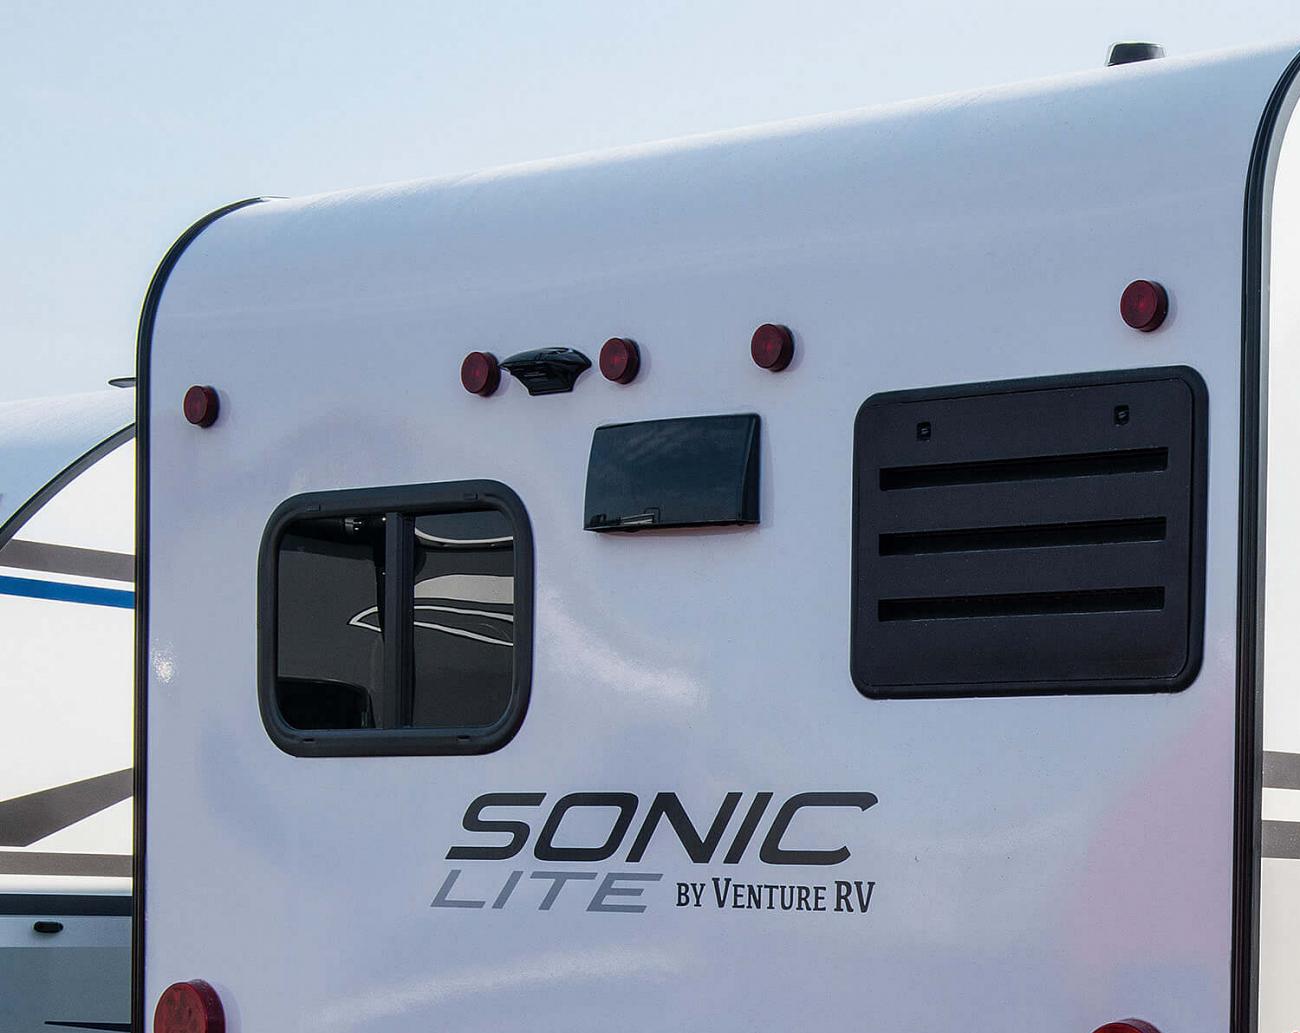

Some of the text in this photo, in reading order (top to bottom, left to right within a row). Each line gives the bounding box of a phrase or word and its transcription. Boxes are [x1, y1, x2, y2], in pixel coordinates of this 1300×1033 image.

[444, 791, 879, 866] SONIC
[430, 869, 876, 914] LITE BY VENTURE RV
